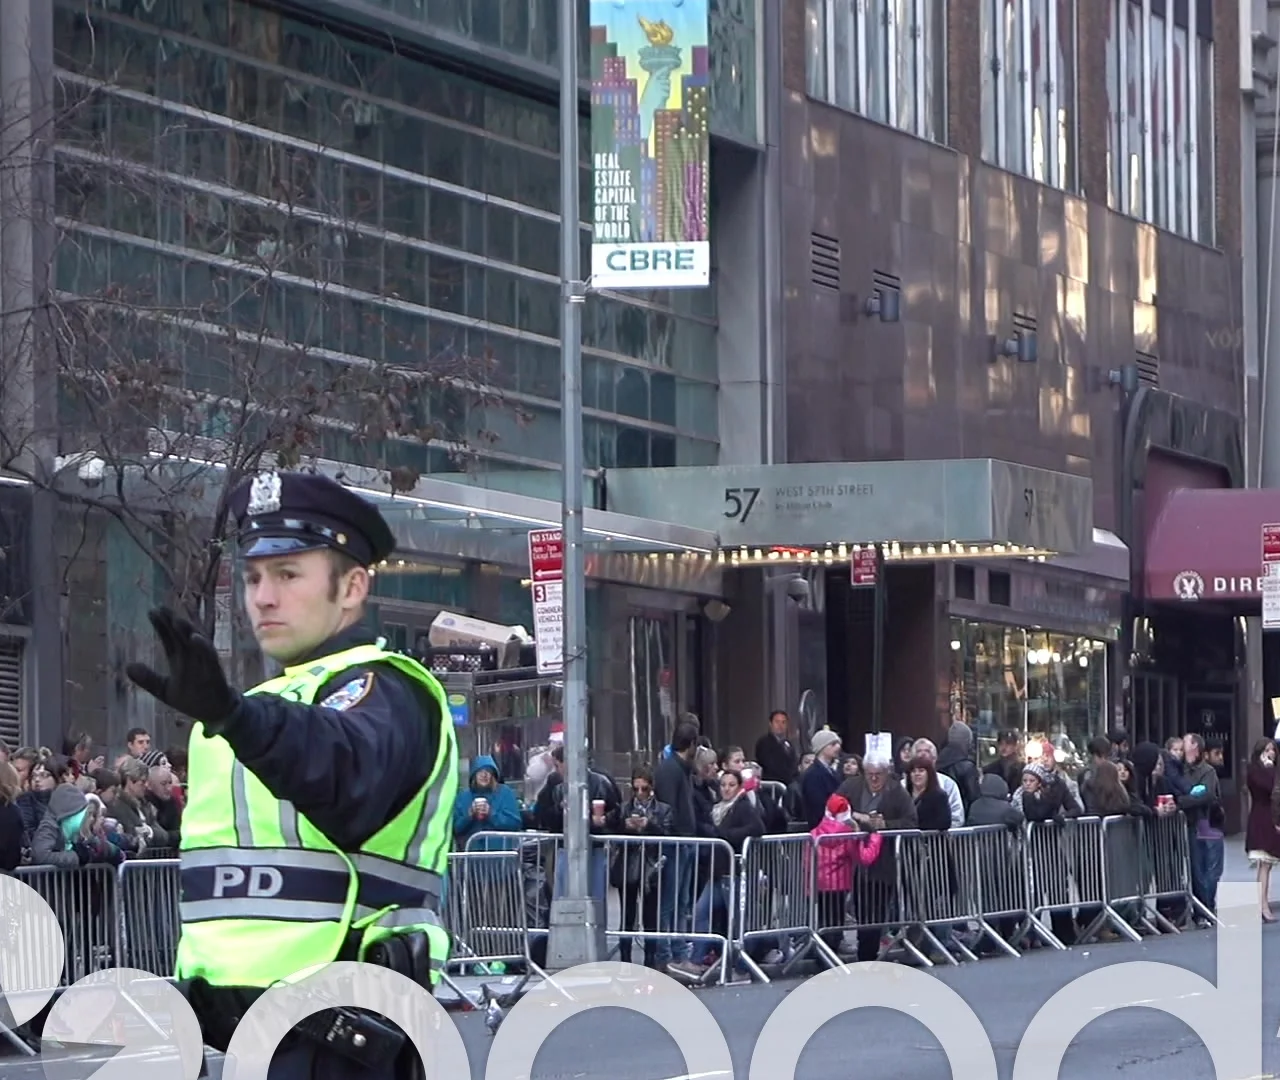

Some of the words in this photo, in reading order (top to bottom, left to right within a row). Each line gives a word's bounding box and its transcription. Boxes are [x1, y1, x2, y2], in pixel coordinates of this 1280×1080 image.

[594, 152, 620, 170] REAL
[594, 170, 632, 187] ESTATE
[594, 187, 637, 204] CAPITAL
[594, 204, 608, 222] OF
[610, 204, 630, 222] THE
[594, 221, 631, 239] WORLD
[605, 248, 695, 271] CBRE
[723, 487, 761, 524] 57
[775, 486, 803, 498] WEST
[837, 483, 875, 497] STREET
[543, 532, 561, 540] STAND
[536, 585, 544, 602] 3
[537, 606, 562, 615] COMMER
[213, 865, 284, 898] PD
